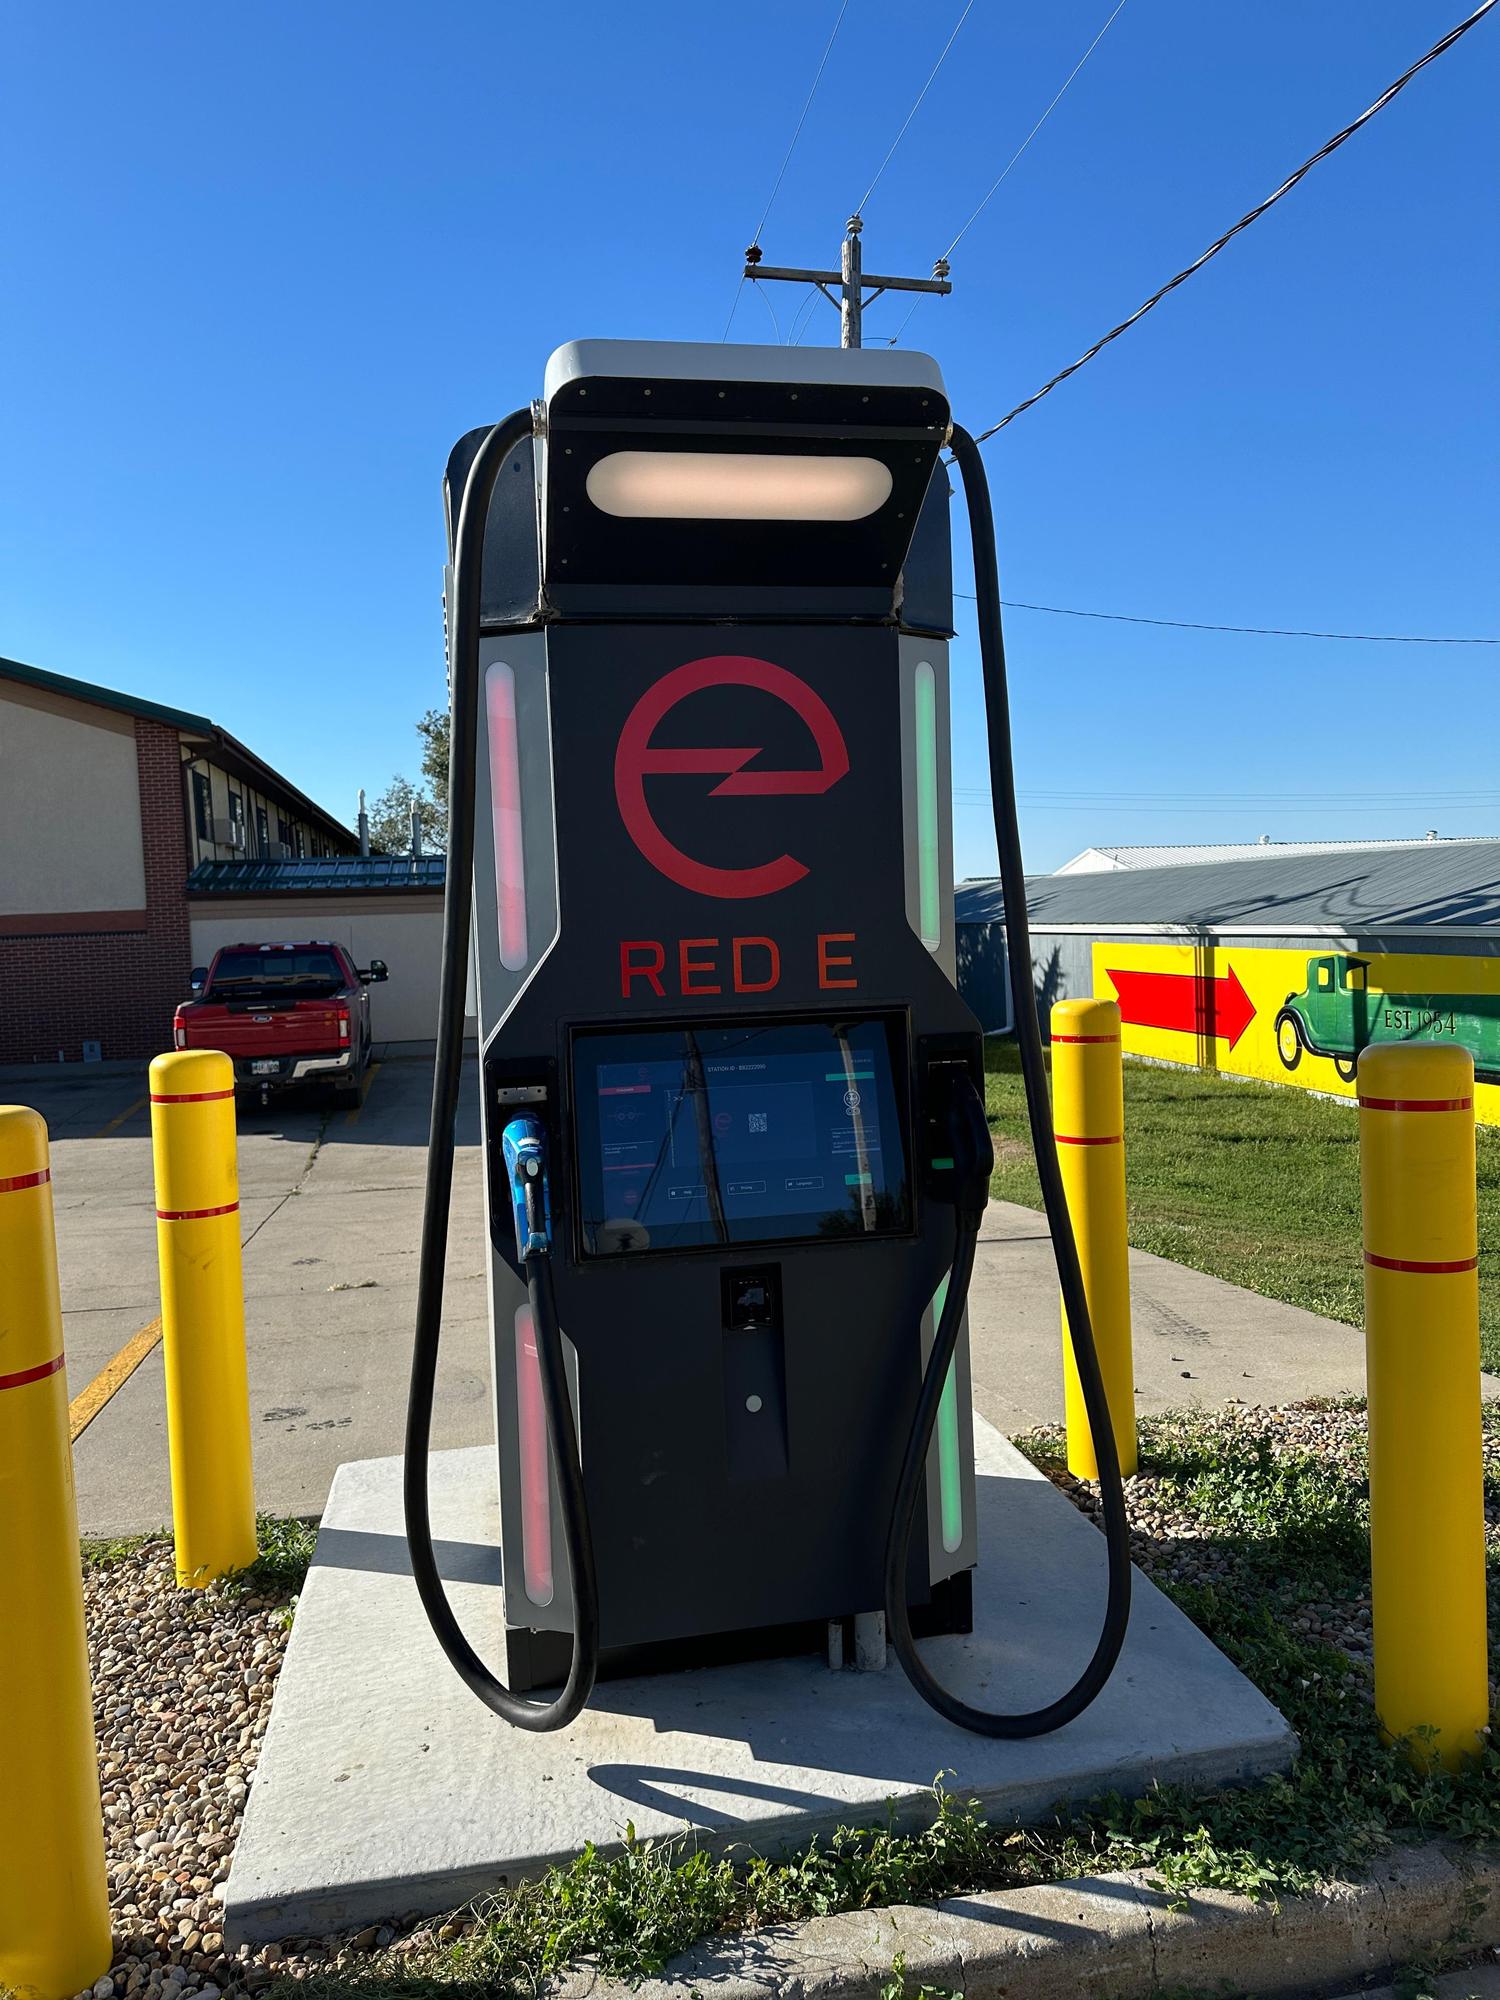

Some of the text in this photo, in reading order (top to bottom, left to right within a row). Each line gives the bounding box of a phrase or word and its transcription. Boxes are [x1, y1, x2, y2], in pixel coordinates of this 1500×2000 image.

[620, 933, 858, 998] RED E
[1384, 1010, 1456, 1035] EST. 1954
